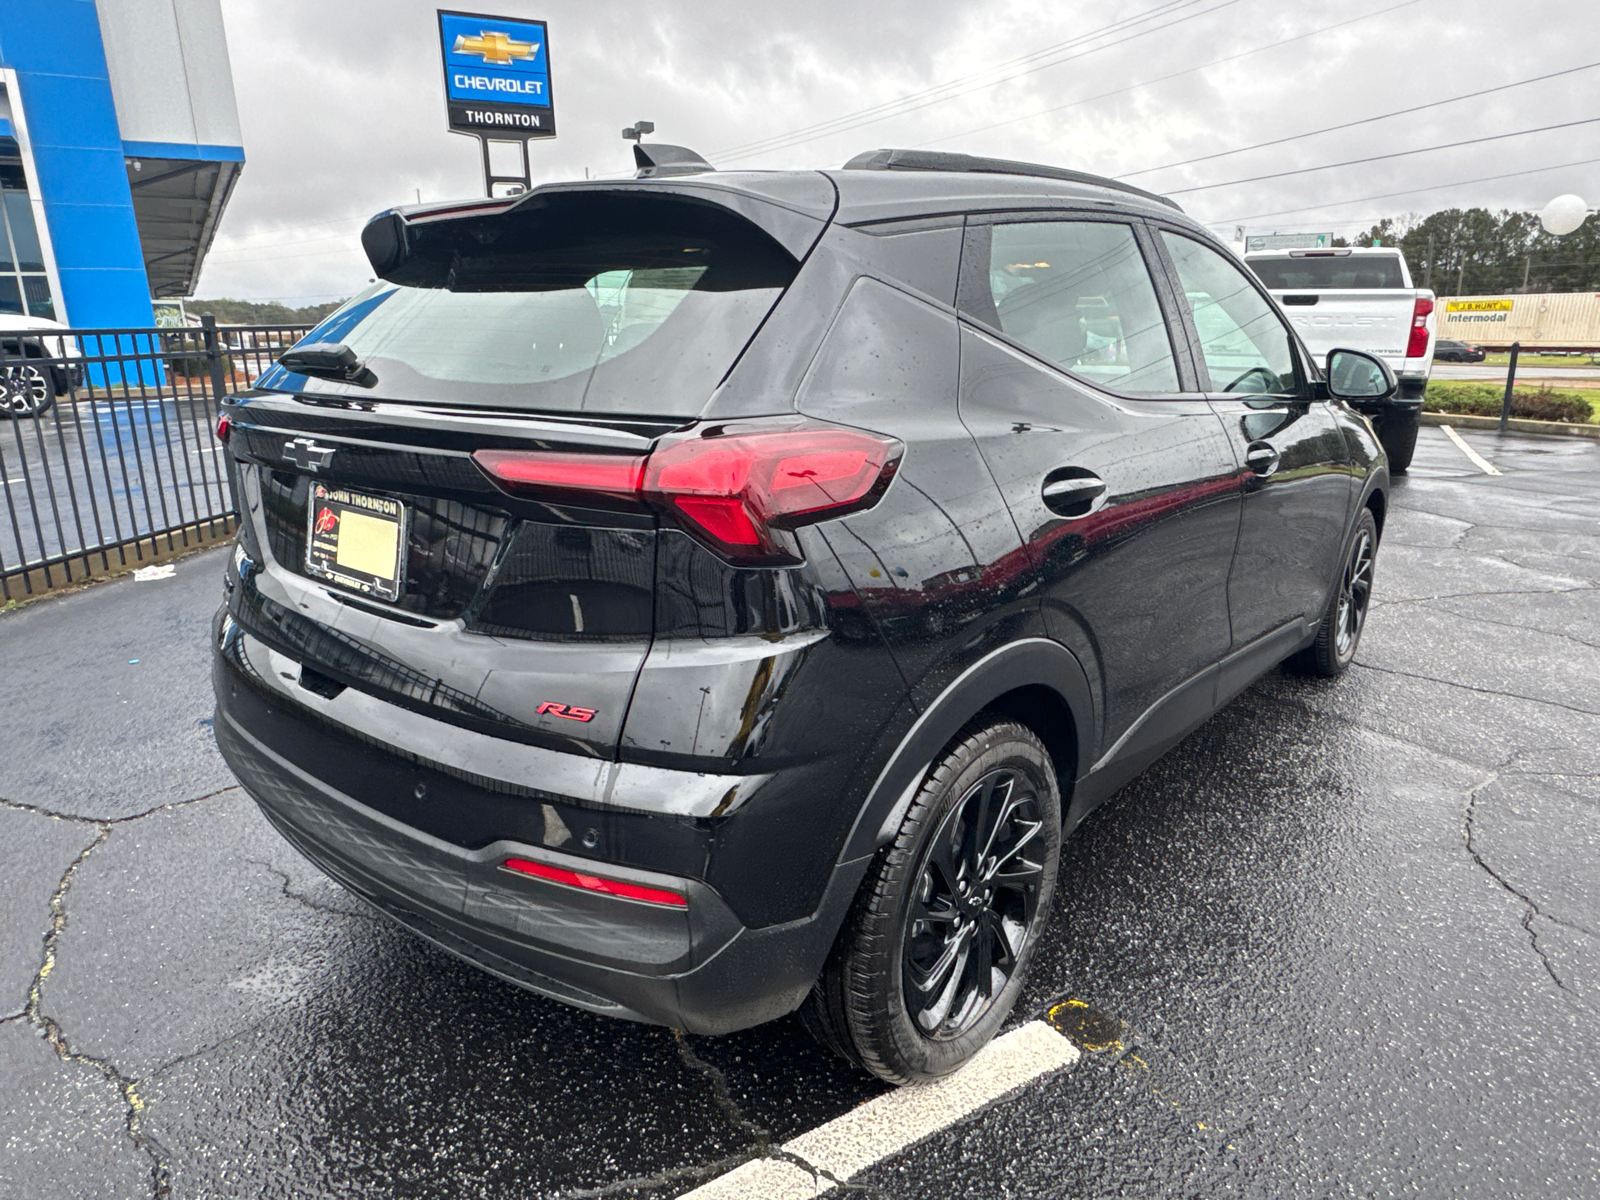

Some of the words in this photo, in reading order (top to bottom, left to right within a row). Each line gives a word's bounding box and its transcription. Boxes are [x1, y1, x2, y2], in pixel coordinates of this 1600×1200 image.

[454, 74, 543, 95] CHEVROLET
[466, 110, 540, 127] THORNTON
[1475, 302, 1499, 310] HUNT
[1290, 315, 1397, 327] ROLET
[1447, 313, 1507, 323] Intermodal
[329, 490, 350, 504] JOHN
[536, 701, 597, 722] RS
